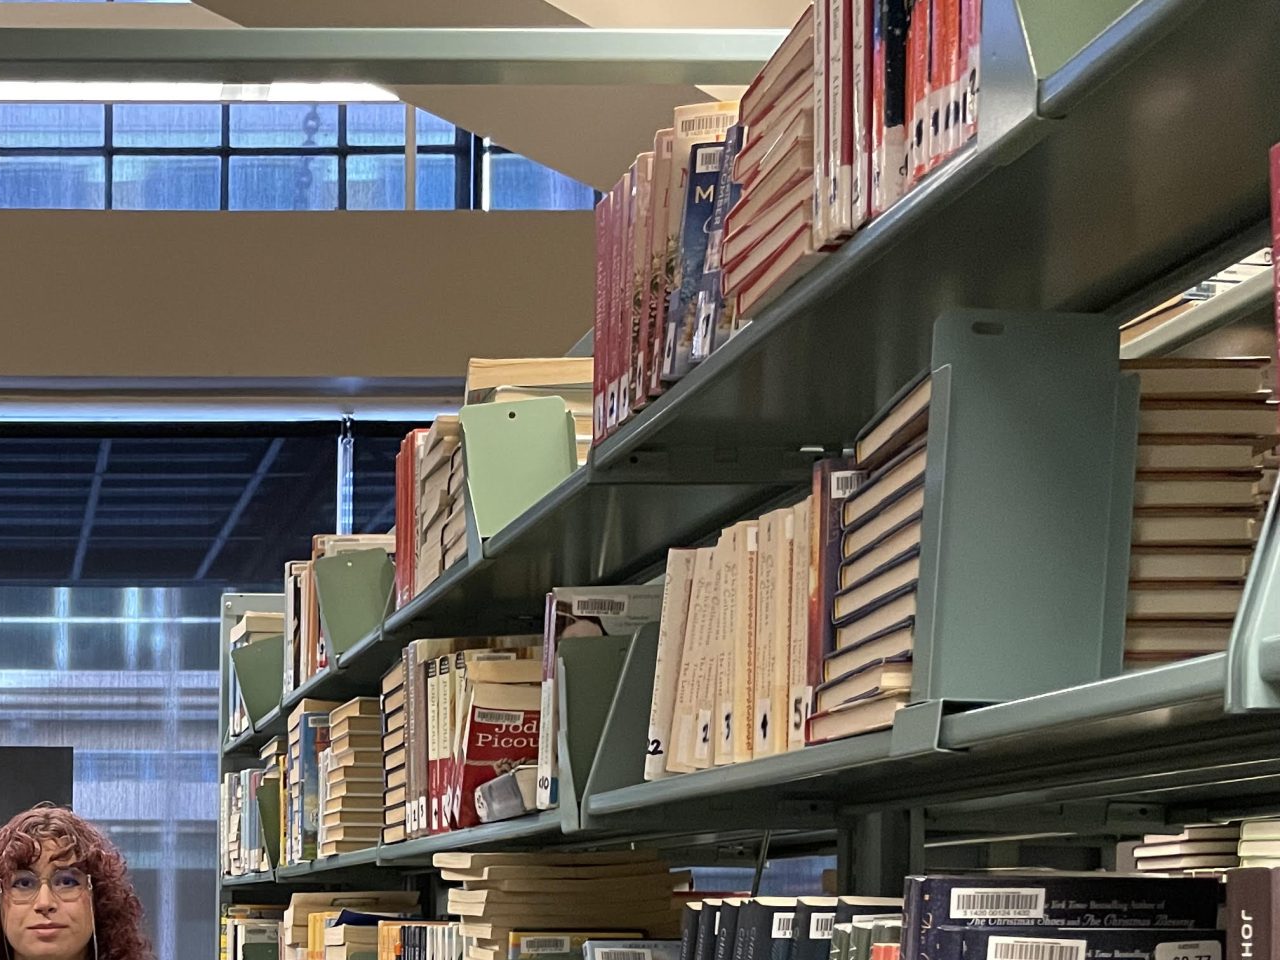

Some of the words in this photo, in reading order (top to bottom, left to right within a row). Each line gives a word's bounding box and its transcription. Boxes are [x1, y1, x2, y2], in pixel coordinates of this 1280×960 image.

[495, 720, 538, 734] Jod
[476, 733, 539, 748] Picou
[967, 917, 985, 927] The
[988, 917, 1035, 927] Christmas
[1037, 915, 1065, 927] Shoes
[1082, 914, 1102, 927] The
[1104, 914, 1152, 927] Christmas
